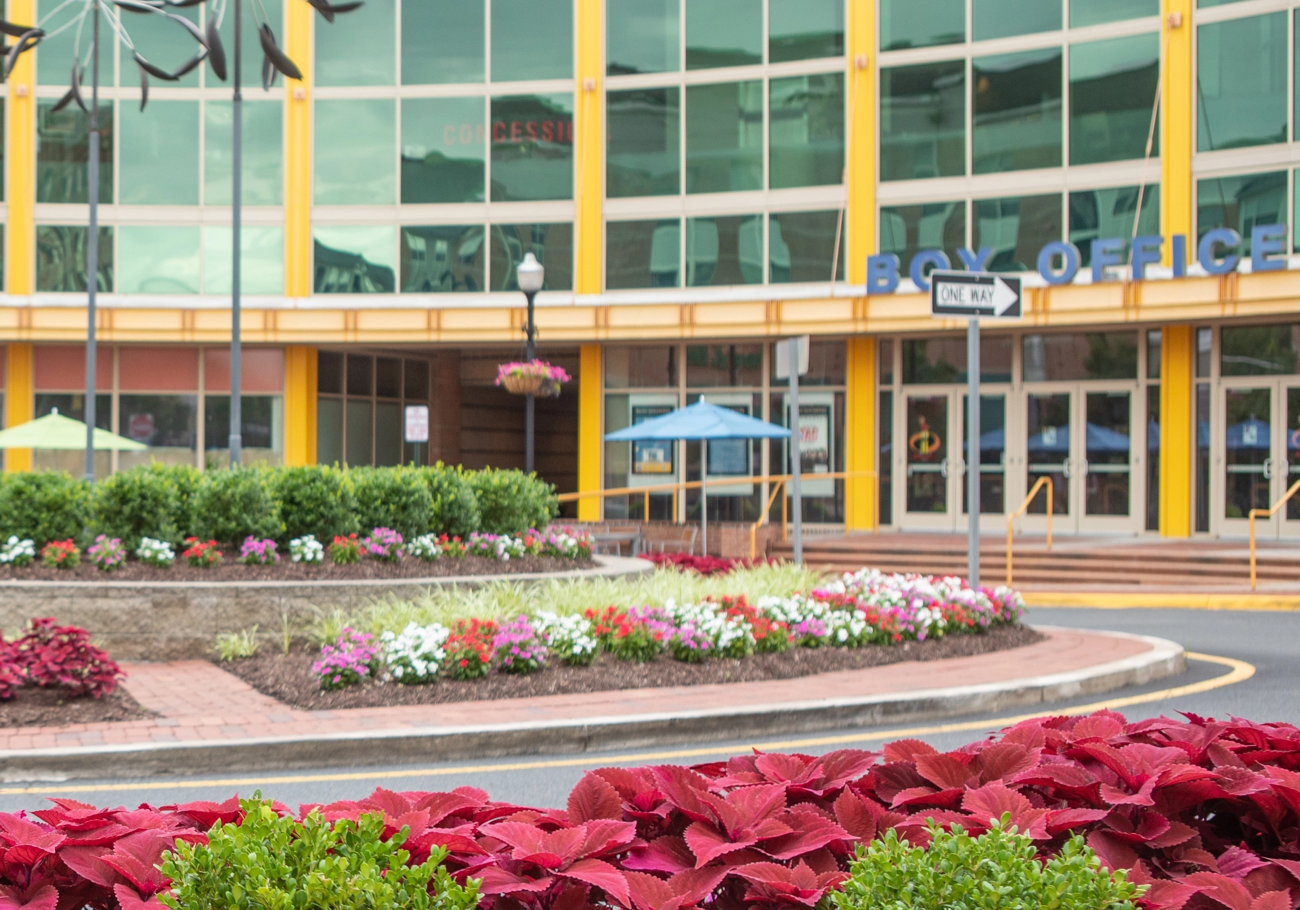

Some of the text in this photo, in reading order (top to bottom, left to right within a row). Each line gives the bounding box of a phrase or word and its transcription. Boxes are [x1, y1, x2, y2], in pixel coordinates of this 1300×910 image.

[866, 223, 1287, 295] BOX OFFICE
[941, 285, 995, 303] ONE WAY
